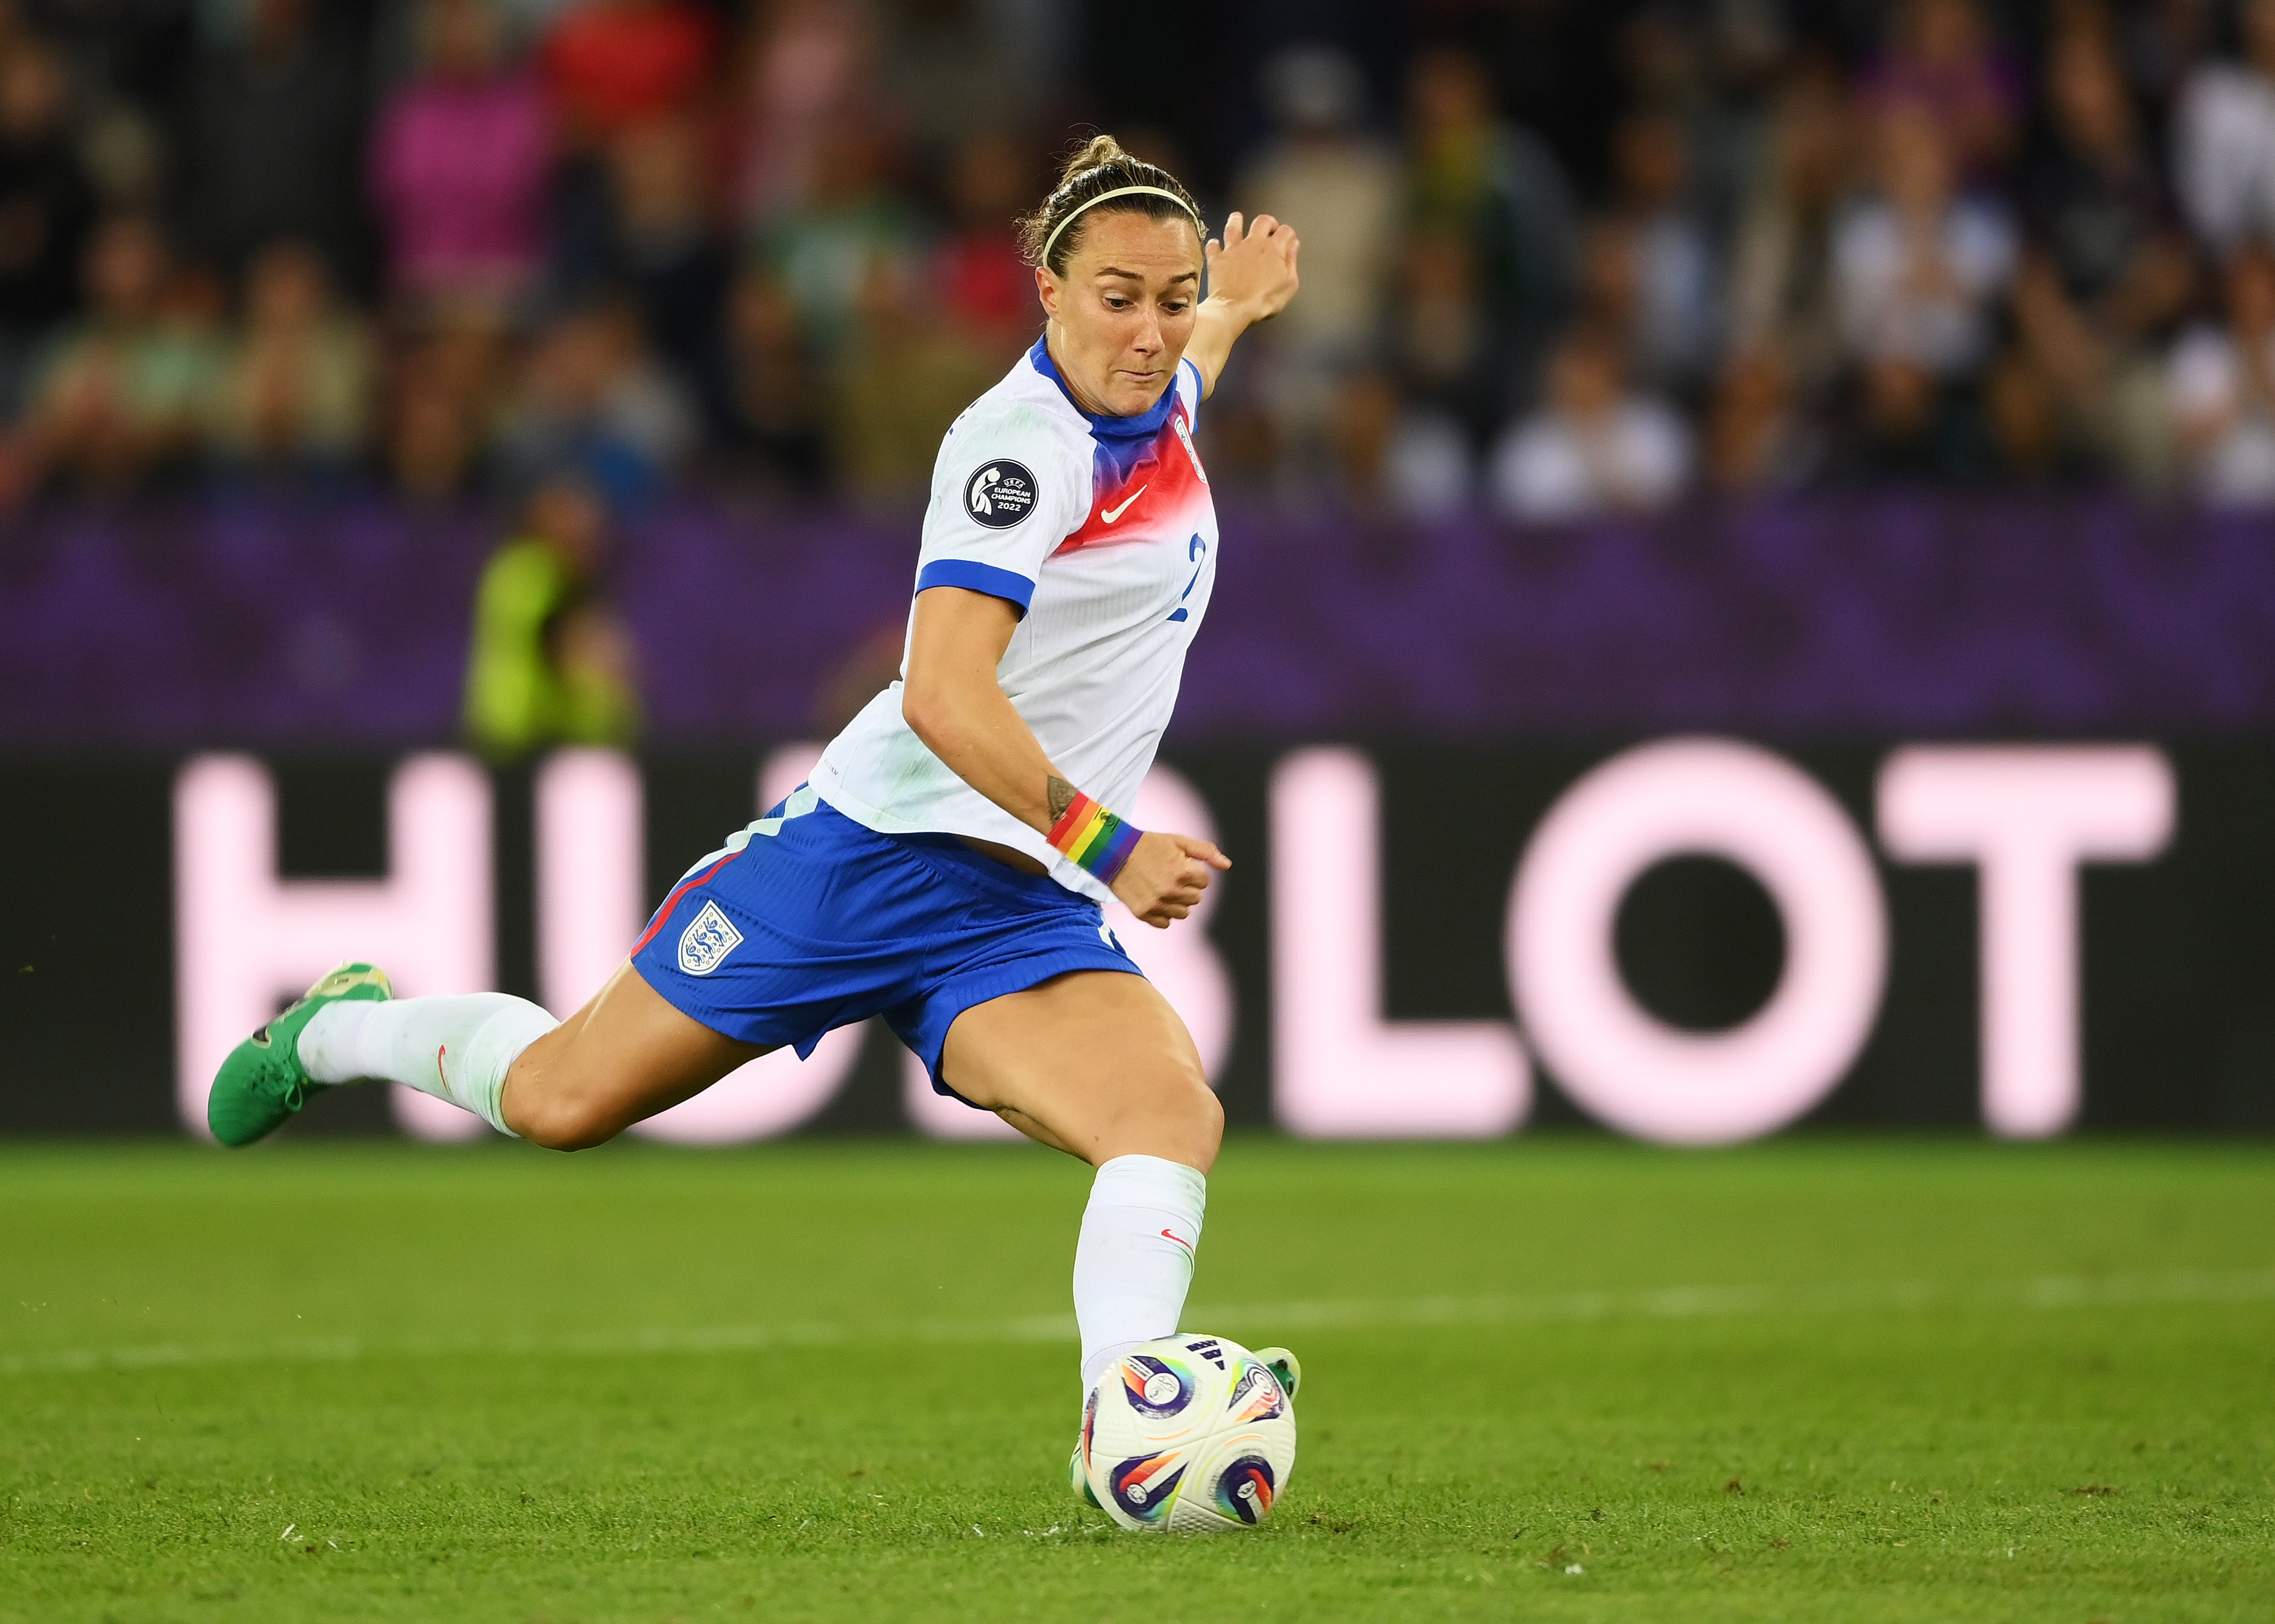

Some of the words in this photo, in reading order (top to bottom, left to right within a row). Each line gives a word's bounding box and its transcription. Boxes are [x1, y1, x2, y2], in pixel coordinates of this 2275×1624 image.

[1004, 479, 1024, 488] UEFA
[994, 487, 1031, 498] EUROPEAN
[991, 493, 1031, 505] CHAMPIONS
[998, 502, 1021, 512] 2022
[1166, 532, 1206, 622] 2
